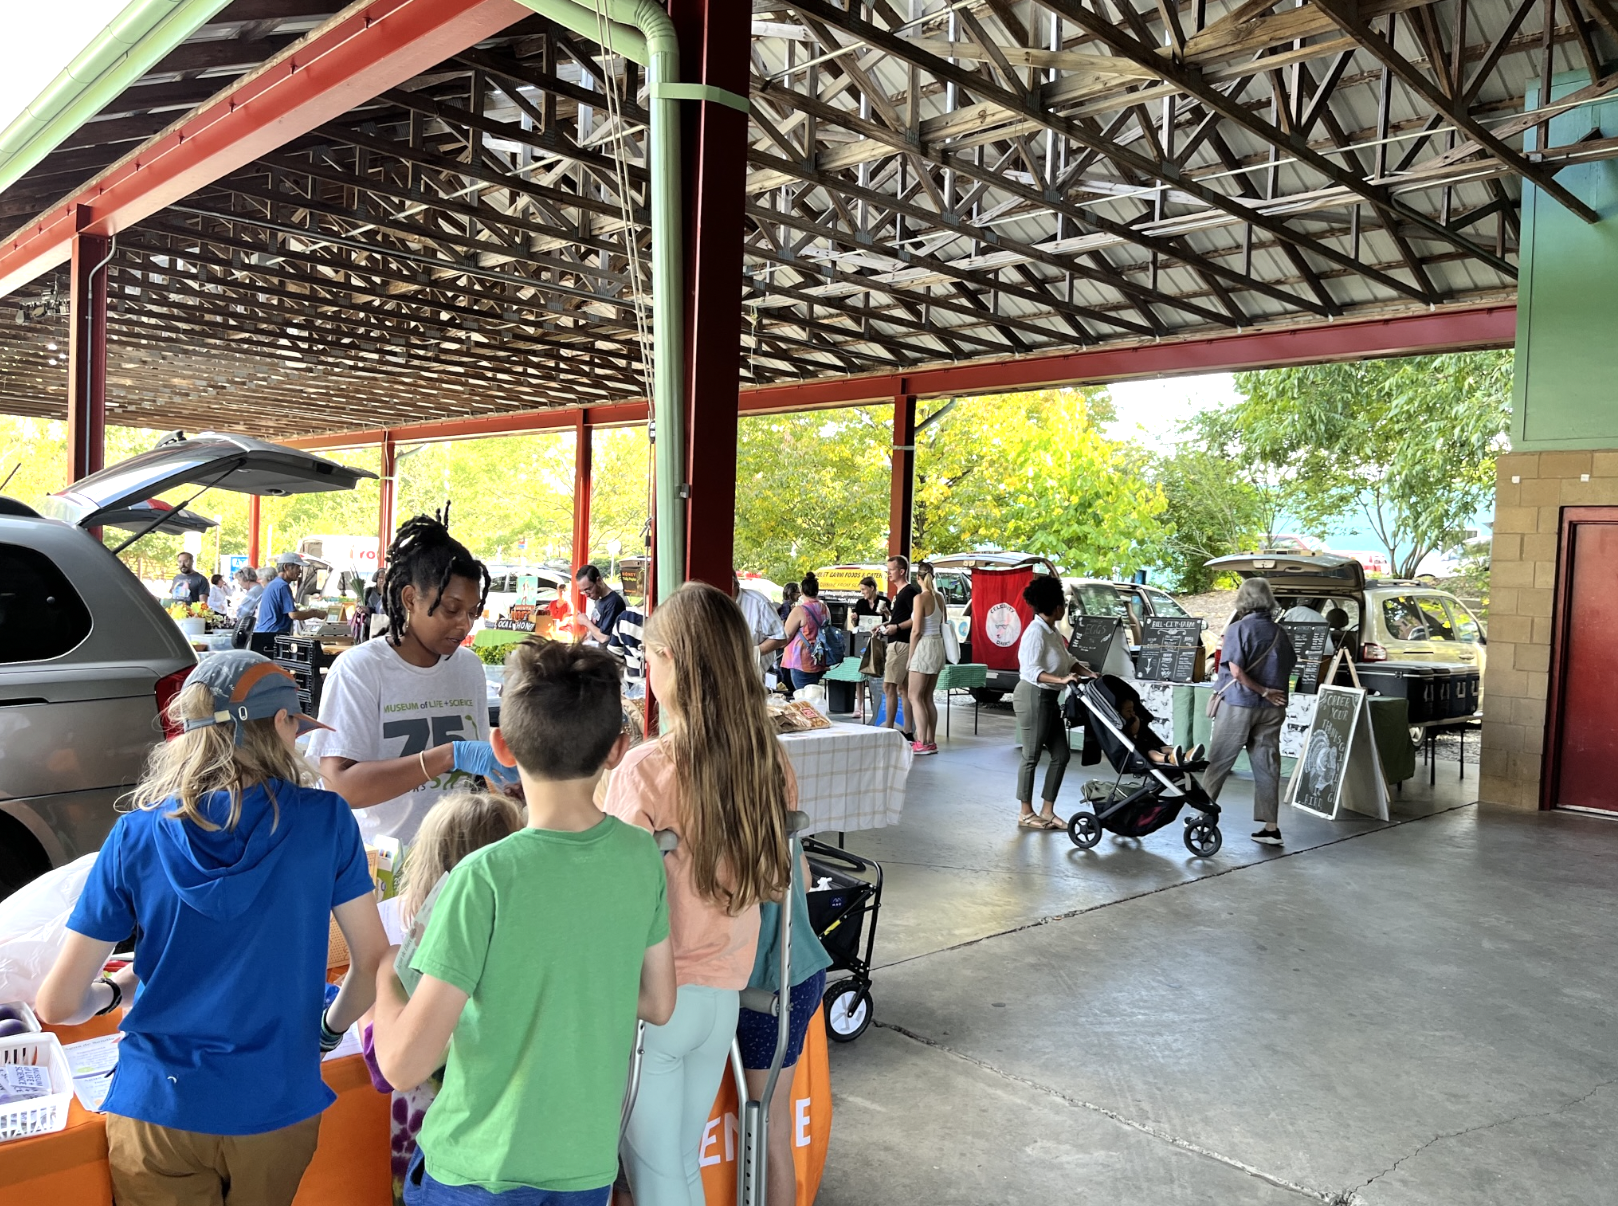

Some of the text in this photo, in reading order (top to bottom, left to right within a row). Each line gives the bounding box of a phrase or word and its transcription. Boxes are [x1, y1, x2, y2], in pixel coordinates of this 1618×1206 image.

[1085, 623, 1107, 635] EGGS
[384, 702, 419, 713] MUSEUM
[420, 701, 428, 709] of
[429, 700, 444, 708] LIFE
[449, 699, 474, 707] SCIENCE
[1327, 695, 1351, 708] ORDER
[1331, 707, 1349, 721] YOUR
[15, 1066, 27, 1086] SCIENCE
[25, 1071, 35, 1083] LIFE
[33, 1067, 43, 1087] MUSEUM
